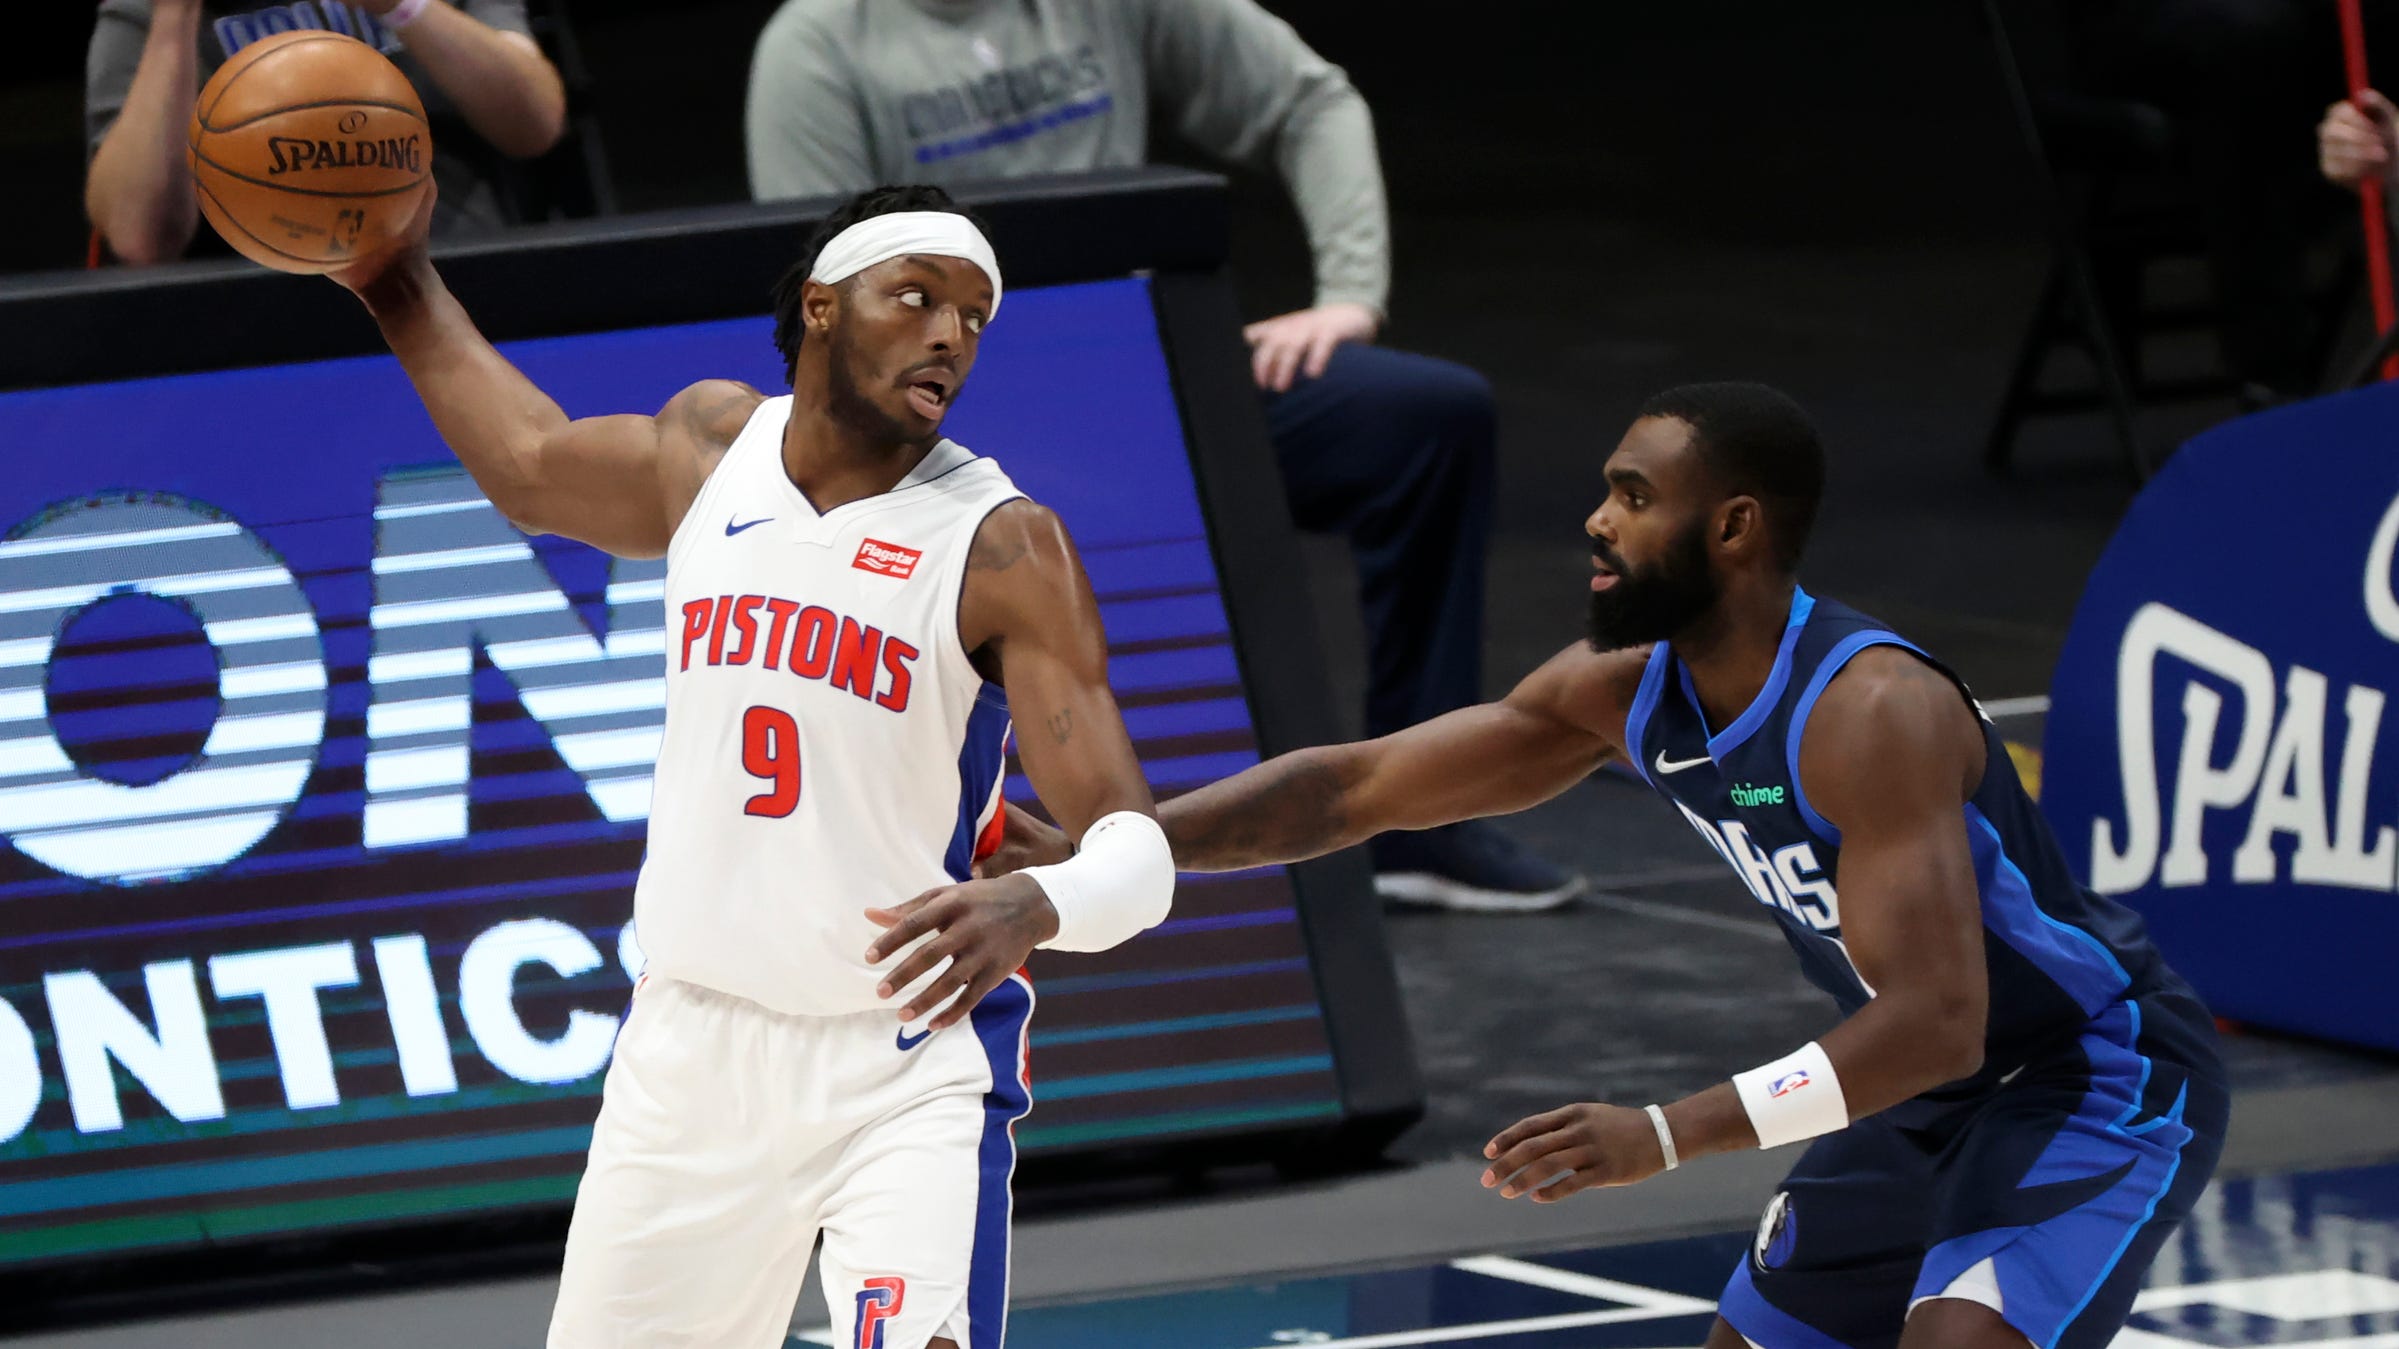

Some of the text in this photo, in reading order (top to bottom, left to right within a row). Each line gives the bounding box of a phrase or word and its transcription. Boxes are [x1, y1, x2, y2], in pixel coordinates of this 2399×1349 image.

[268, 133, 422, 175] SPALDING
[860, 542, 917, 566] Flagstar
[680, 594, 920, 713] PISTONS
[742, 705, 801, 818] 9
[1730, 782, 1785, 807] chime
[2090, 602, 2399, 895] SPAL
[0, 916, 648, 1145] NTIC
